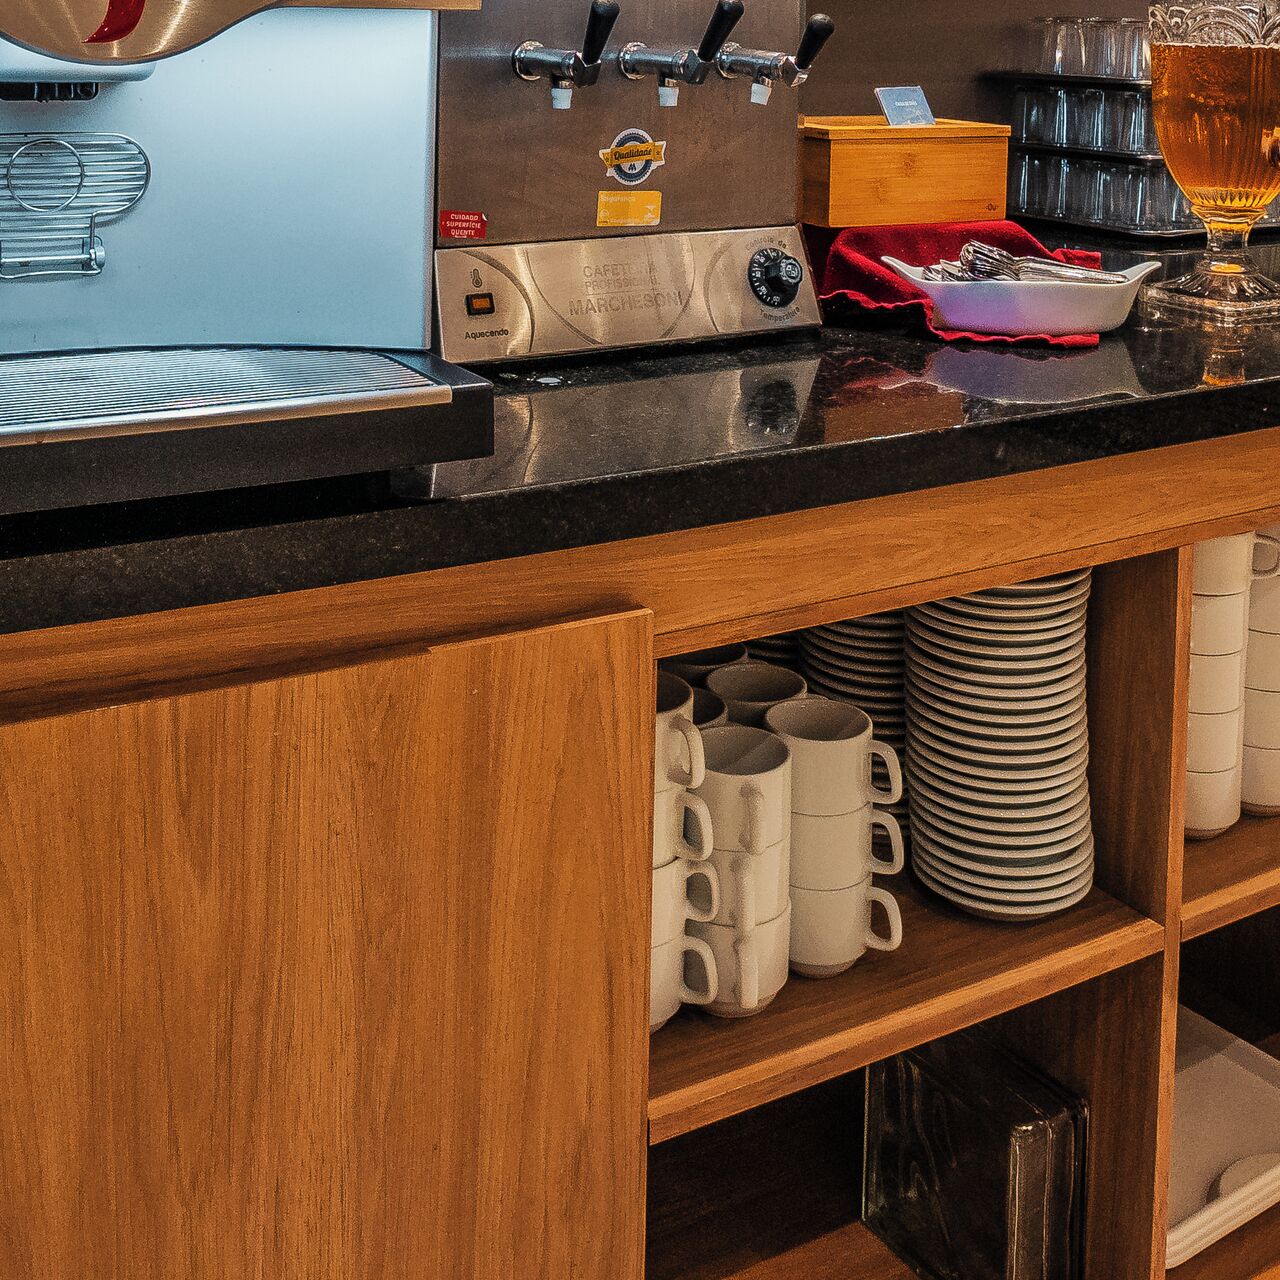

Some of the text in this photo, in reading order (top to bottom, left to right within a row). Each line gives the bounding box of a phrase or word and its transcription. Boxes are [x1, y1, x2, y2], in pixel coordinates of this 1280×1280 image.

[450, 213, 479, 221] CUIDADO
[450, 228, 476, 236] QUENTE
[464, 328, 509, 340] Aquecendo
